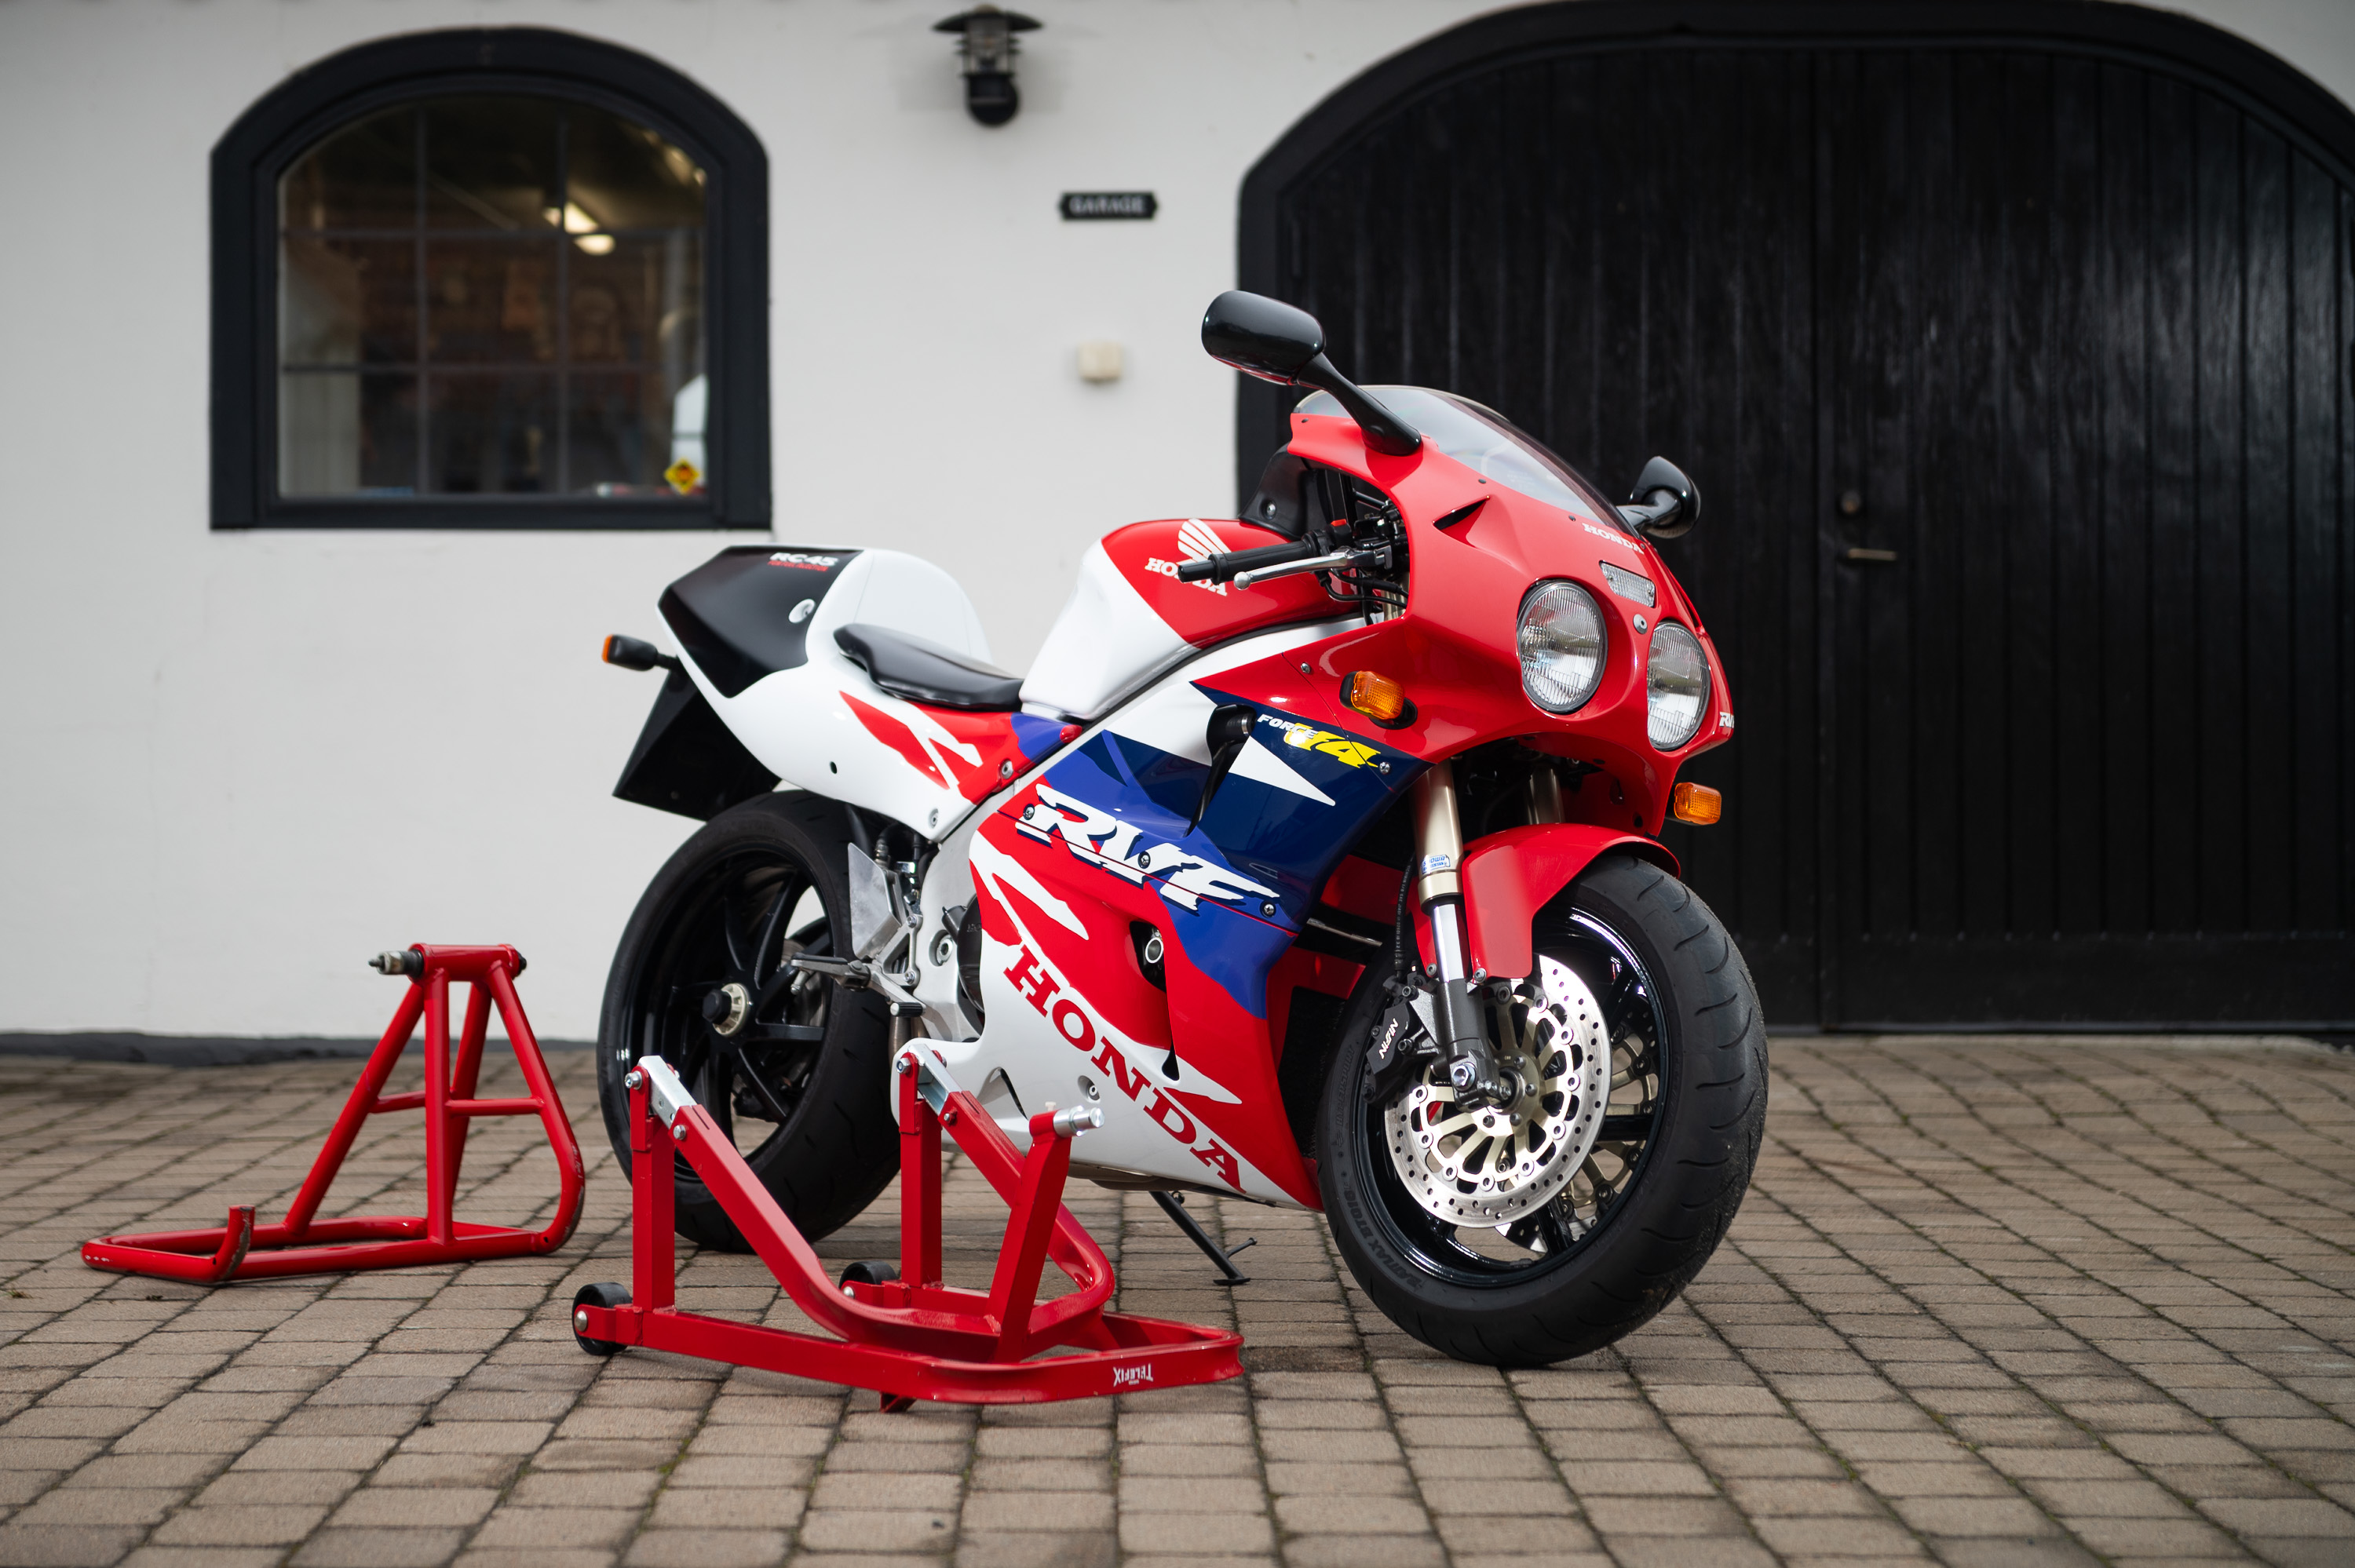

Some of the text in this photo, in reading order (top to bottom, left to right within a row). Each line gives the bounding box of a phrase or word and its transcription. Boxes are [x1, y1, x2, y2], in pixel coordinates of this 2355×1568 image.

[1068, 196, 1144, 214] GARAGE
[1582, 523, 1645, 555] HONDA
[769, 552, 838, 566] RC45
[1257, 713, 1382, 768] FORCE V4
[1015, 783, 1280, 916] RVF
[1003, 944, 1247, 1194] HONDA
[1112, 1362, 1153, 1387] TELEFIX
